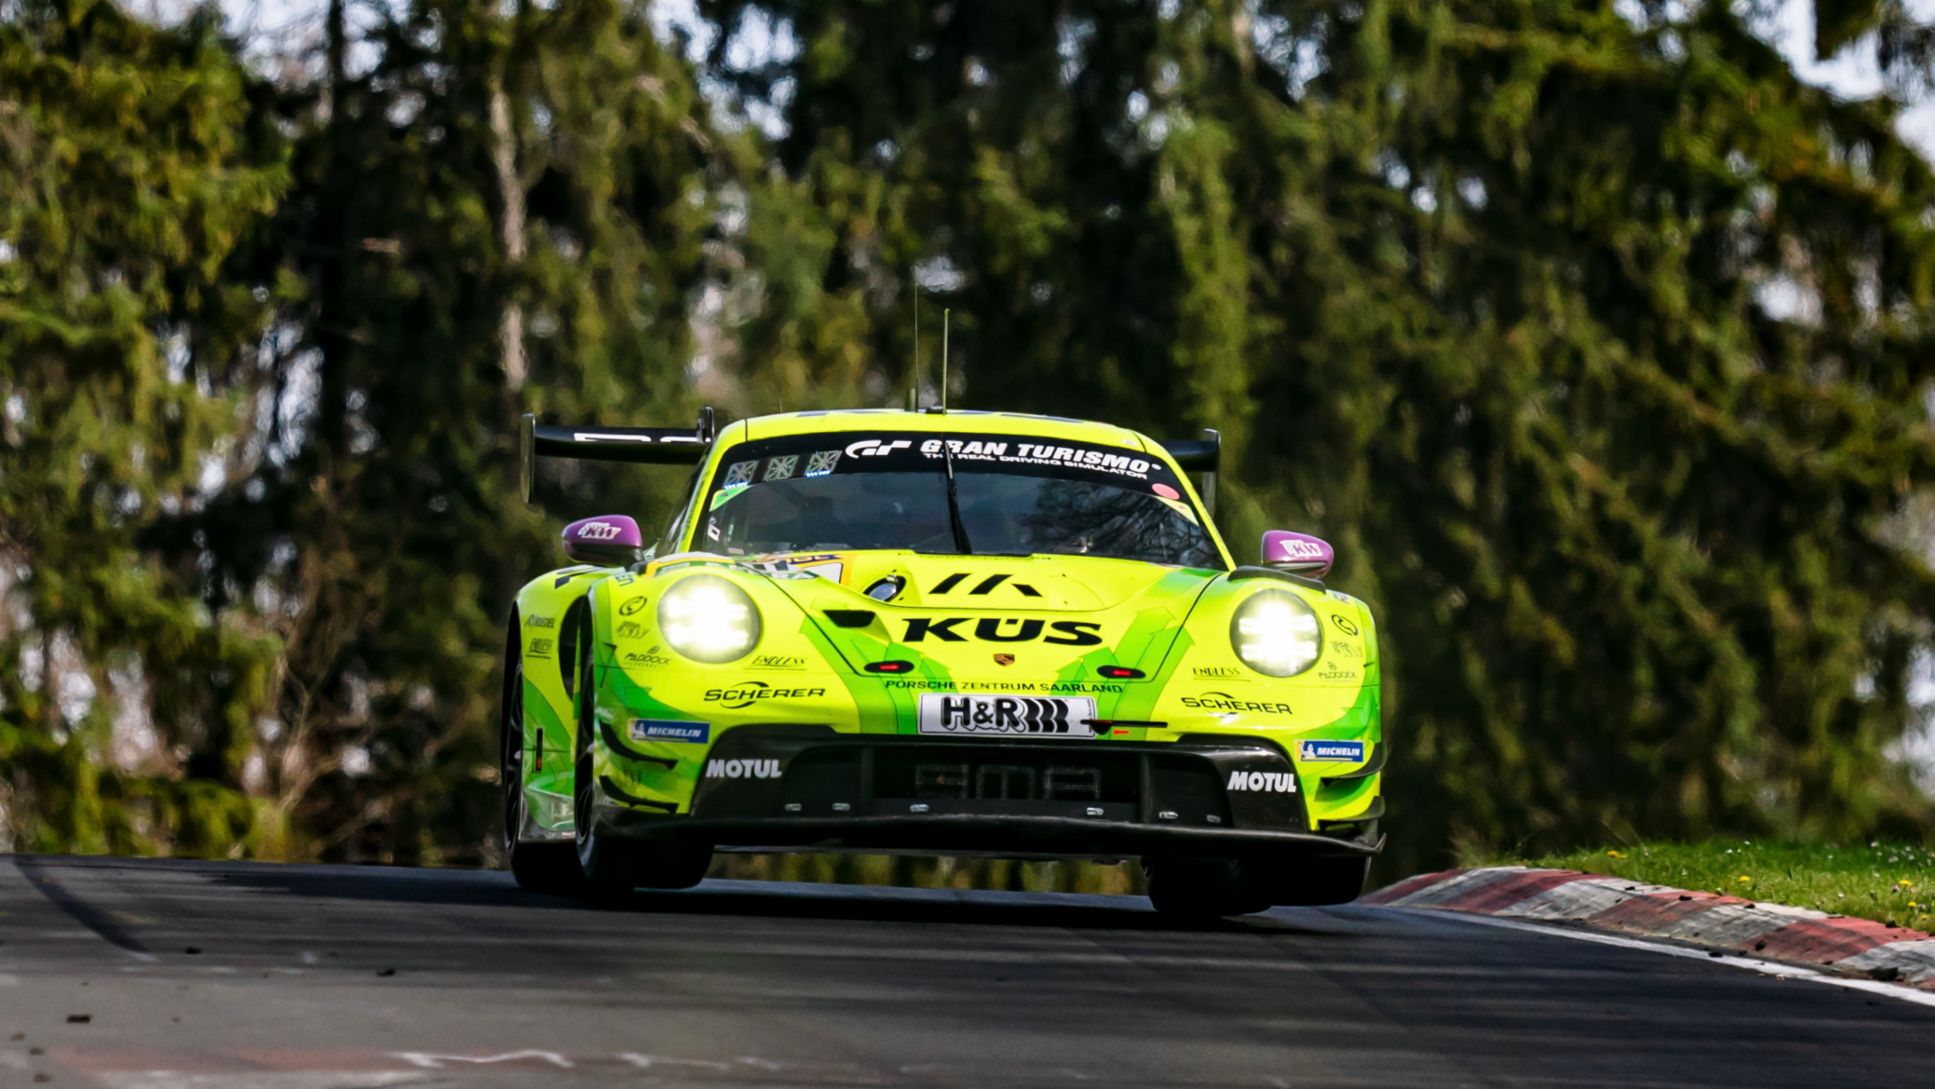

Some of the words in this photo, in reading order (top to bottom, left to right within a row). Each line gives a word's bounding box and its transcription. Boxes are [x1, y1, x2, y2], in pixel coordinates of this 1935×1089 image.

[920, 439, 1005, 456] GRAN
[1018, 443, 1150, 473] TURISMO
[923, 452, 953, 460] TH
[958, 453, 996, 462] REAL
[999, 456, 1062, 466] DRIVING
[1063, 461, 1148, 480] SIMULATOR
[901, 617, 1103, 646] KÜS
[752, 655, 808, 666] ENDLESS
[1193, 667, 1241, 677] ENDLESS
[703, 686, 826, 703] SCHERER
[885, 680, 956, 690] PORSCHE
[961, 682, 1035, 691] ZENTRUM
[1040, 683, 1123, 694] SAARLAND
[941, 697, 1024, 730] H&R
[1181, 696, 1293, 715] SCHERER
[647, 726, 702, 739] MICHELIN
[1316, 746, 1361, 756] MICHELIN
[705, 759, 783, 779] MOTUL
[1227, 771, 1297, 793] MOTUL
